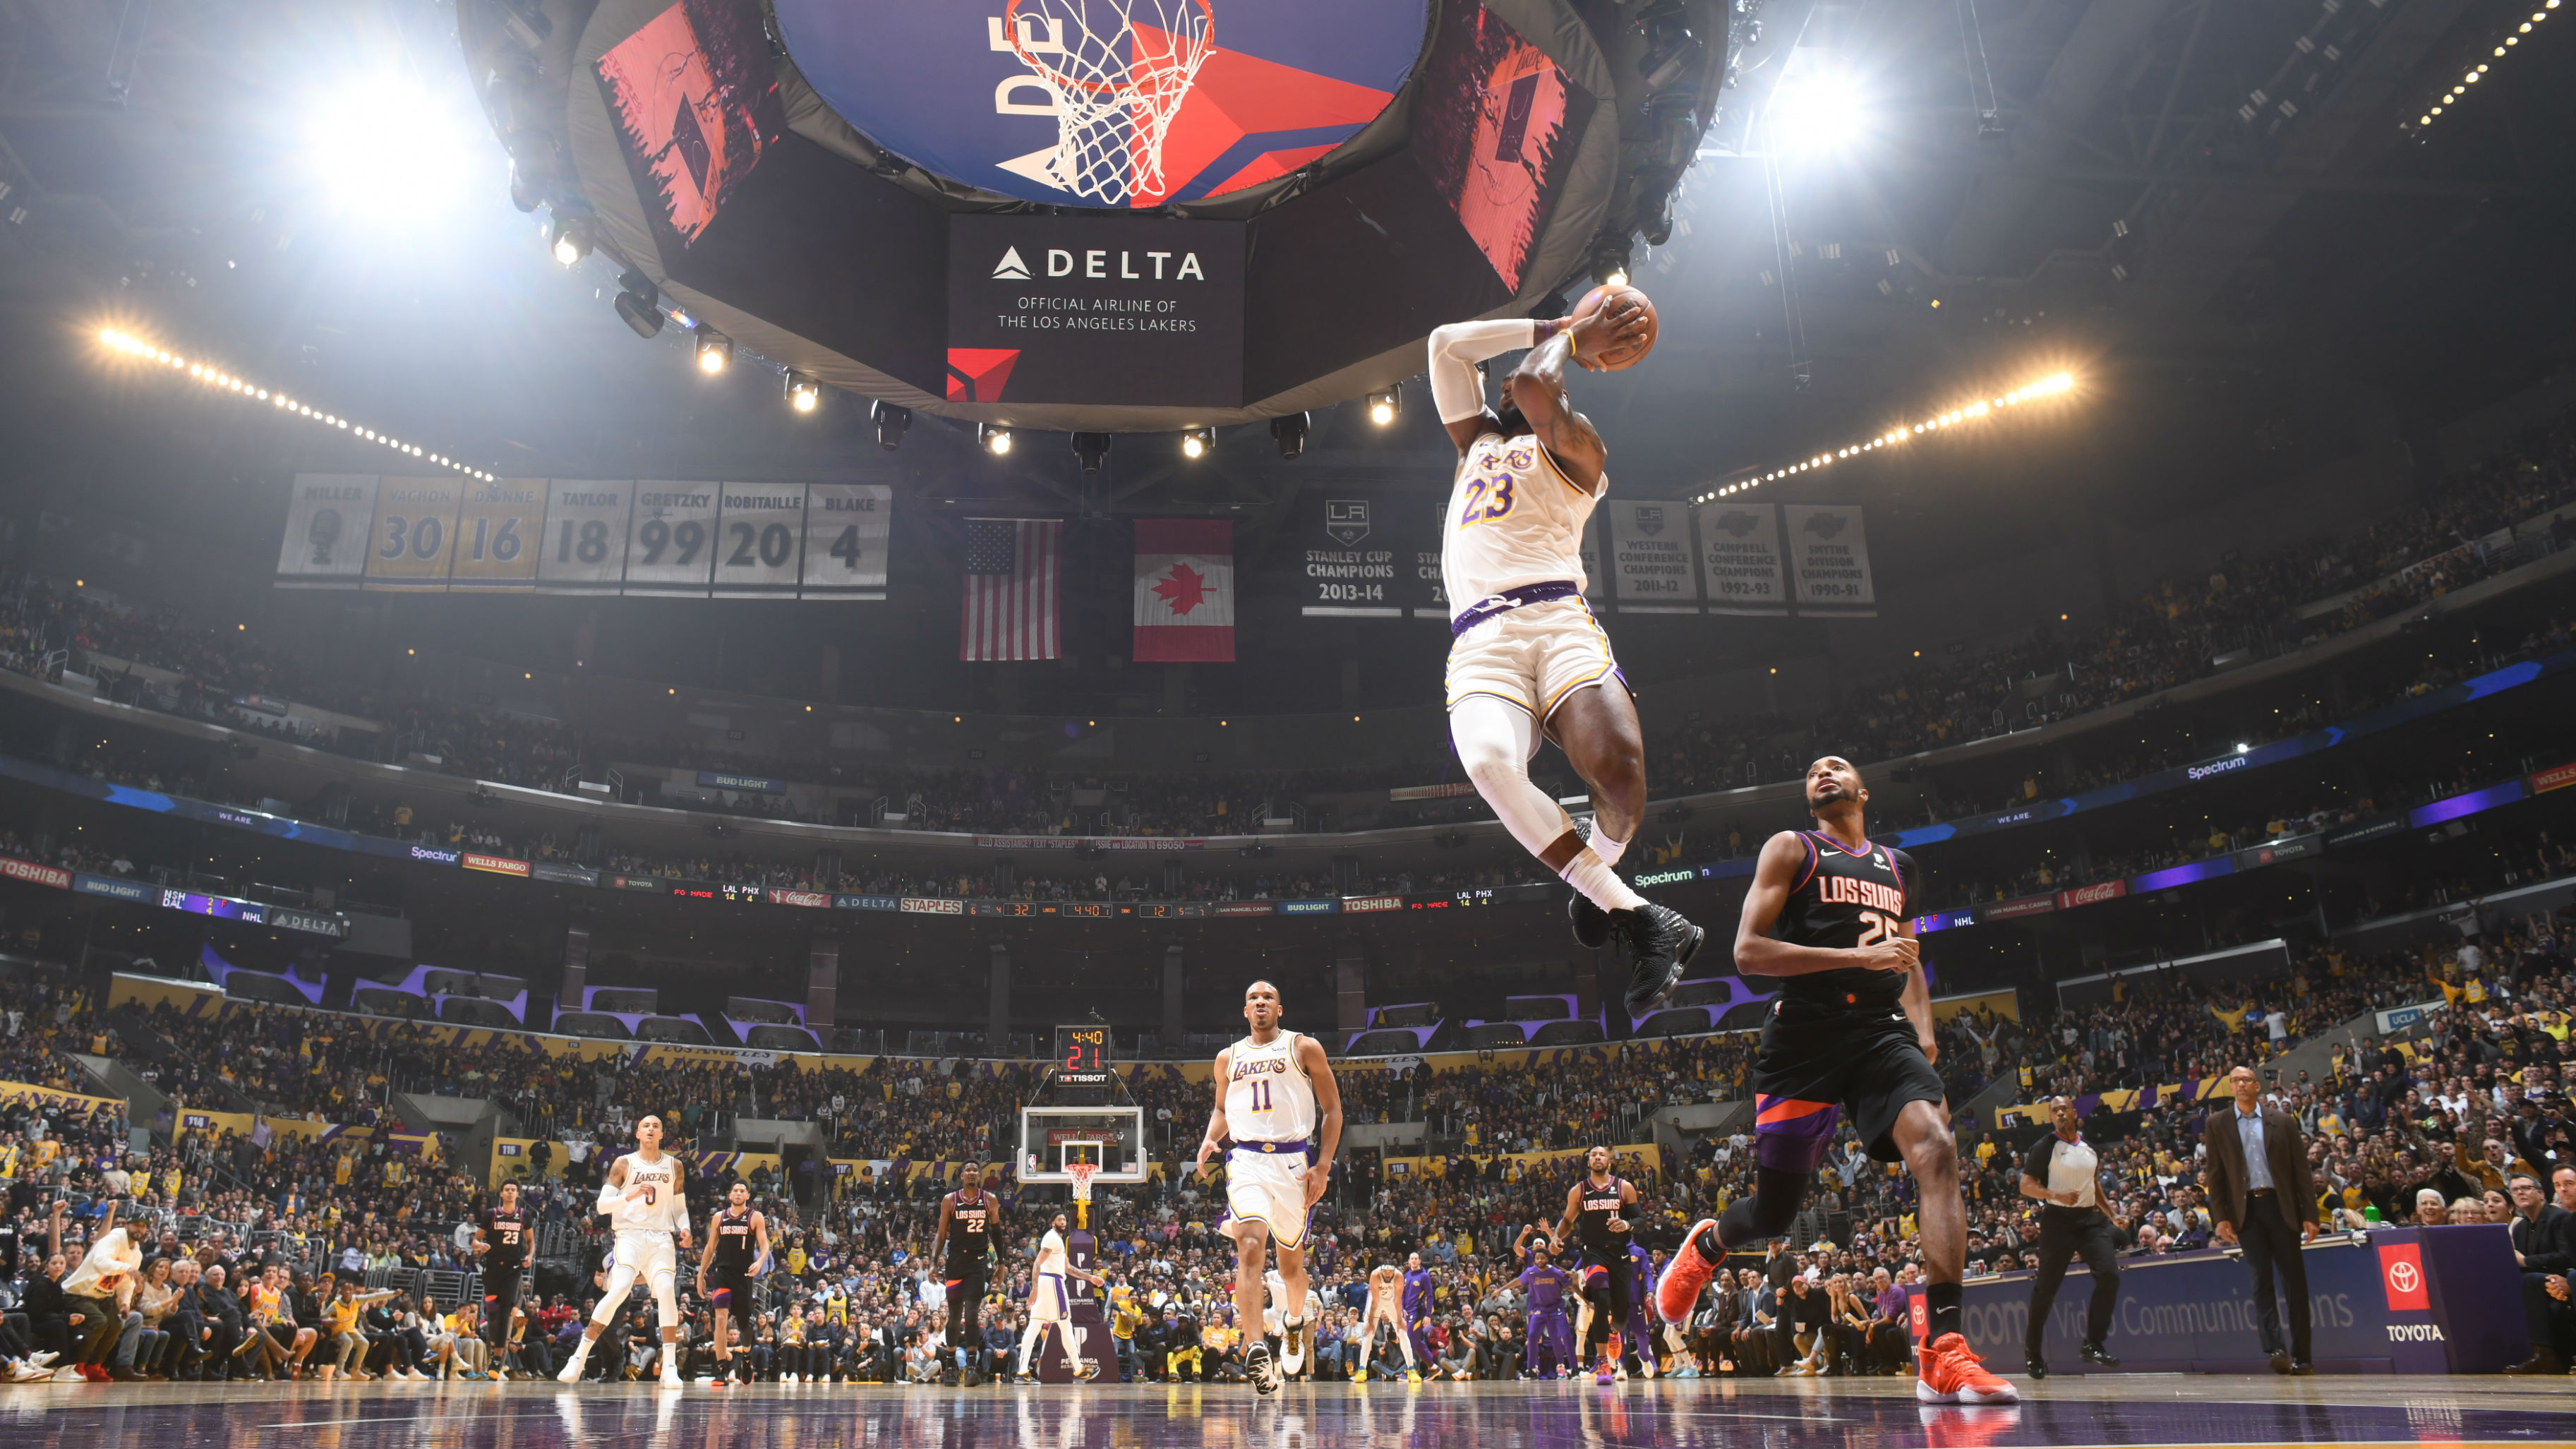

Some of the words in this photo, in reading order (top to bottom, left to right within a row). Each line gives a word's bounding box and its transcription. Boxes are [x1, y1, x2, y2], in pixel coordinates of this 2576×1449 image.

[1047, 249, 1205, 281] DELTA
[1018, 296, 1087, 312] OFFICIAL
[1093, 299, 1152, 313] AIRLINE
[1157, 300, 1177, 313] OF
[998, 315, 1028, 328] THE
[1032, 315, 1060, 329] LOS
[1066, 317, 1135, 331] ANGELES
[1140, 318, 1196, 332] LAKERS
[304, 487, 363, 500] MILLER
[390, 489, 451, 503] VACHON
[562, 492, 618, 507] TAYLOR
[640, 493, 711, 508] GRETZKY
[724, 495, 802, 510] ROBITAILLE
[825, 498, 876, 512] BLAKE
[1459, 471, 1515, 531] 23
[1330, 505, 1365, 519] LA
[379, 515, 445, 560] 30
[471, 517, 522, 563] 16
[557, 519, 608, 563] 18
[639, 519, 706, 565] 99
[725, 522, 792, 567] 20
[829, 524, 862, 570] 4
[1627, 540, 1679, 551] WESTERN
[1713, 543, 1769, 554] CAMPBELL
[1807, 544, 1850, 555] SMYTHE
[1306, 550, 1361, 563] STANLEY
[1366, 551, 1393, 563] CUP
[1619, 552, 1688, 564] CONFERENCE
[1708, 553, 1776, 565] CONFERENCE
[1807, 556, 1855, 567] DIVISION
[1306, 564, 1395, 578] CHAMPIONS
[1624, 564, 1687, 576] CHAMPIONS
[1712, 566, 1775, 578] CHAMPIONS
[1801, 568, 1863, 580] CHAMPIONS
[1319, 583, 1383, 600] 2013-14
[1634, 579, 1680, 593] 2011-12
[1721, 581, 1770, 595] 1992-93
[1810, 584, 1859, 597] 1990-91
[2188, 756, 2246, 781] Spectrum
[716, 776, 738, 786] BUD
[738, 777, 768, 789] LIGHT
[2536, 767, 2576, 786] WELLS
[218, 811, 232, 822] WE
[977, 838, 993, 847] NEED
[1033, 839, 1047, 848] TEXT
[1096, 840, 1112, 849] ISSUE
[1121, 841, 1148, 850] LOCATION
[1157, 840, 1185, 850] 69050
[2274, 845, 2305, 858] TOYOTA
[468, 856, 496, 867] WELLS
[498, 860, 526, 872] FARGO
[627, 879, 654, 889] TOYOTA
[1635, 870, 1692, 889] Spectrum
[86, 880, 110, 893] BUD
[110, 885, 142, 898] LIGHT
[164, 889, 186, 902] NSH
[722, 884, 738, 894] LAL
[741, 886, 759, 896] PHX
[1457, 891, 1471, 899] LAL
[1476, 889, 1493, 898] PHX
[1817, 875, 1860, 906] LOS
[1859, 882, 1903, 916] SUNS
[725, 892, 735, 901] 14
[746, 894, 753, 903] 4
[851, 898, 896, 909] DELTA
[1343, 898, 1402, 911] TOSHIBA
[1460, 898, 1471, 907] 14
[1481, 897, 1488, 906] 4
[162, 896, 183, 910] DAL
[241, 911, 263, 924] NHL
[902, 898, 961, 914] STAPLES
[1014, 904, 1028, 915] 32
[1154, 906, 1164, 917] 12
[1990, 908, 2004, 916] SAN
[2003, 903, 2029, 913] MANUEL
[2028, 900, 2052, 910] CASINO
[291, 915, 338, 934] DELTA
[1919, 915, 1925, 925] 2
[1921, 924, 1927, 933] 4
[1954, 916, 1975, 927] NHL
[2393, 1013, 2416, 1025] UCLA
[1072, 1030, 1102, 1045] 4:40
[1067, 1045, 1099, 1071] 21
[1232, 1057, 1287, 1082] LAKERS
[1072, 1074, 1107, 1083] TISSOT
[1251, 1078, 1272, 1114] 11
[188, 1115, 205, 1128] 114
[1053, 1134, 1080, 1142] WELL
[502, 1145, 516, 1155] 115
[632, 1171, 670, 1185] LAKERS
[645, 1185, 656, 1207] 0
[1583, 1199, 1599, 1211] LOS
[1599, 1198, 1620, 1210] SUNS
[955, 1210, 968, 1220] LOS
[968, 1210, 986, 1219] SUNS
[494, 1221, 507, 1230] LOS
[506, 1222, 522, 1232] SUNS
[720, 1225, 731, 1235] LOS
[730, 1225, 748, 1235] SUNS
[967, 1219, 985, 1233] 22
[502, 1230, 520, 1245] 23
[742, 1235, 746, 1250] 1
[2385, 1325, 2445, 1342] TOYOTA
